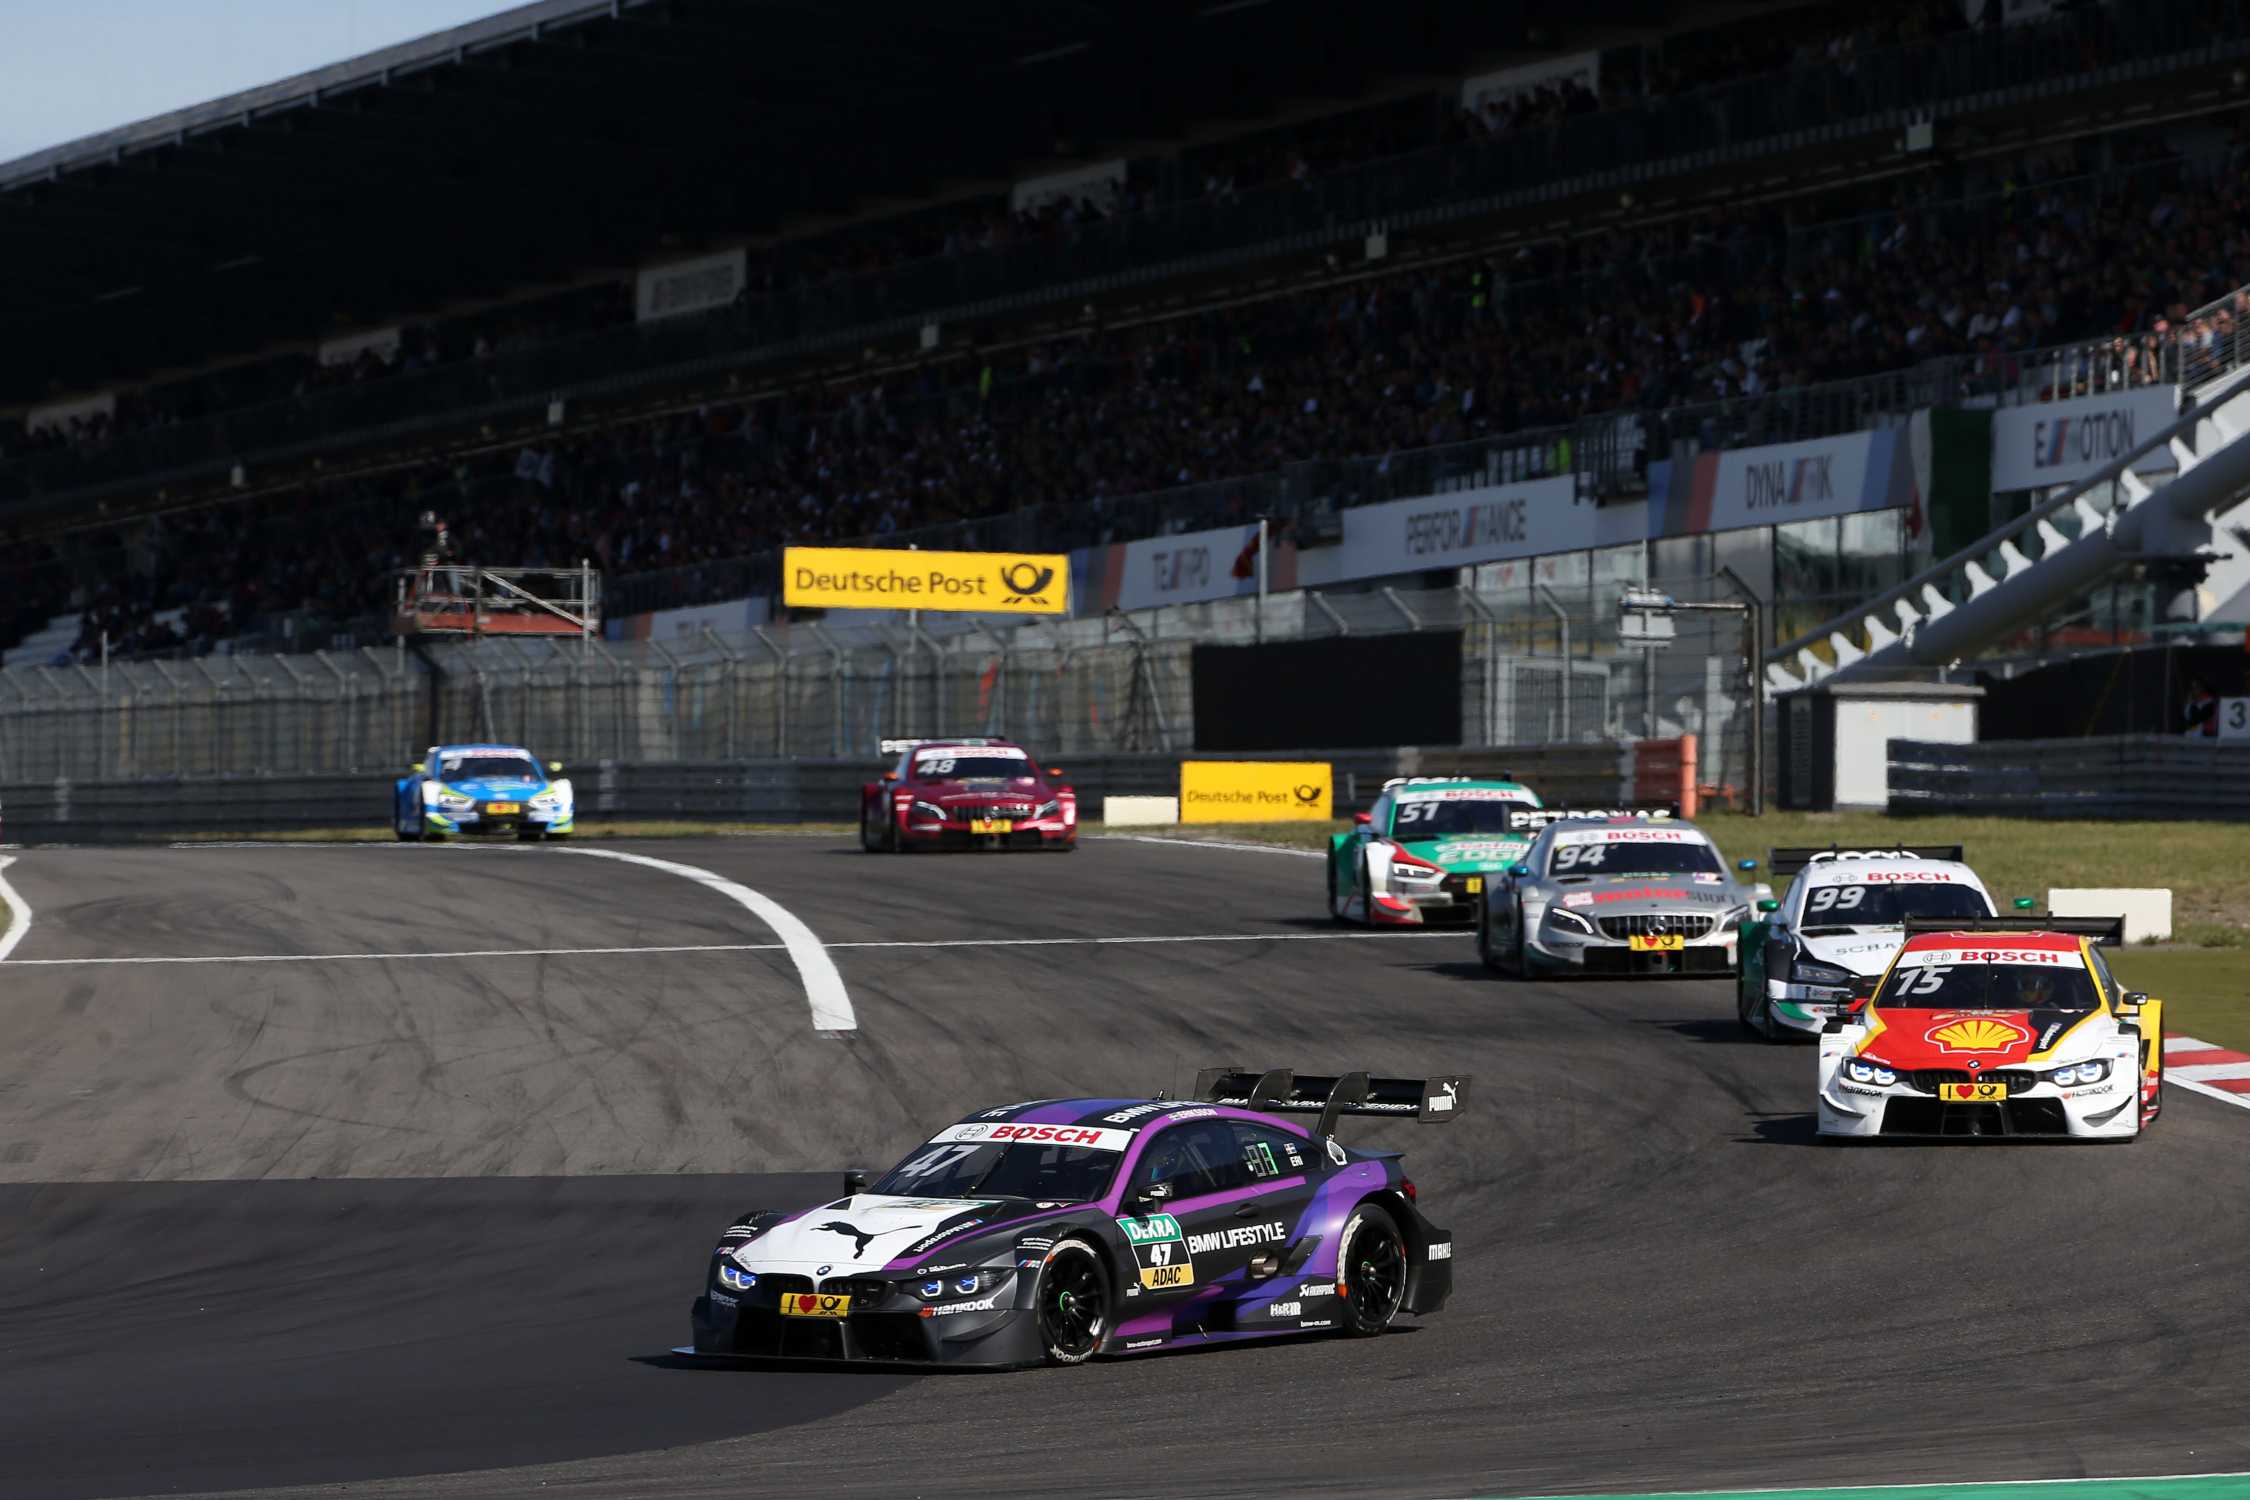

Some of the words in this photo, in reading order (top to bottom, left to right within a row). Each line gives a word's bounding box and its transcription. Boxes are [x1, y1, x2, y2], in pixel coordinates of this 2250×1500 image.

[796, 568, 921, 594] Deutsche
[929, 571, 988, 595] Post
[2229, 701, 2246, 730] 3
[918, 760, 957, 775] 48
[1186, 789, 1253, 803] Deutsche
[1257, 790, 1288, 804] Post
[1397, 803, 1440, 823] 51
[1606, 832, 1681, 841] BOSCH
[1556, 845, 1606, 869] 94
[1866, 873, 1951, 881] BOSCH
[1809, 886, 1867, 913] 99
[1960, 951, 2059, 963] BOSCH
[1895, 967, 1953, 996] 15
[1428, 1095, 1453, 1112] PUMA
[990, 1126, 1103, 1144] BOSCH
[898, 1144, 983, 1179] 47
[1127, 1219, 1176, 1240] DEKRA
[1187, 1231, 1222, 1255] BMW
[1221, 1222, 1287, 1250] LIFESTYLE
[1150, 1243, 1173, 1267] 47
[1428, 1242, 1452, 1261] MAHLE
[1152, 1266, 1182, 1287] ADAC
